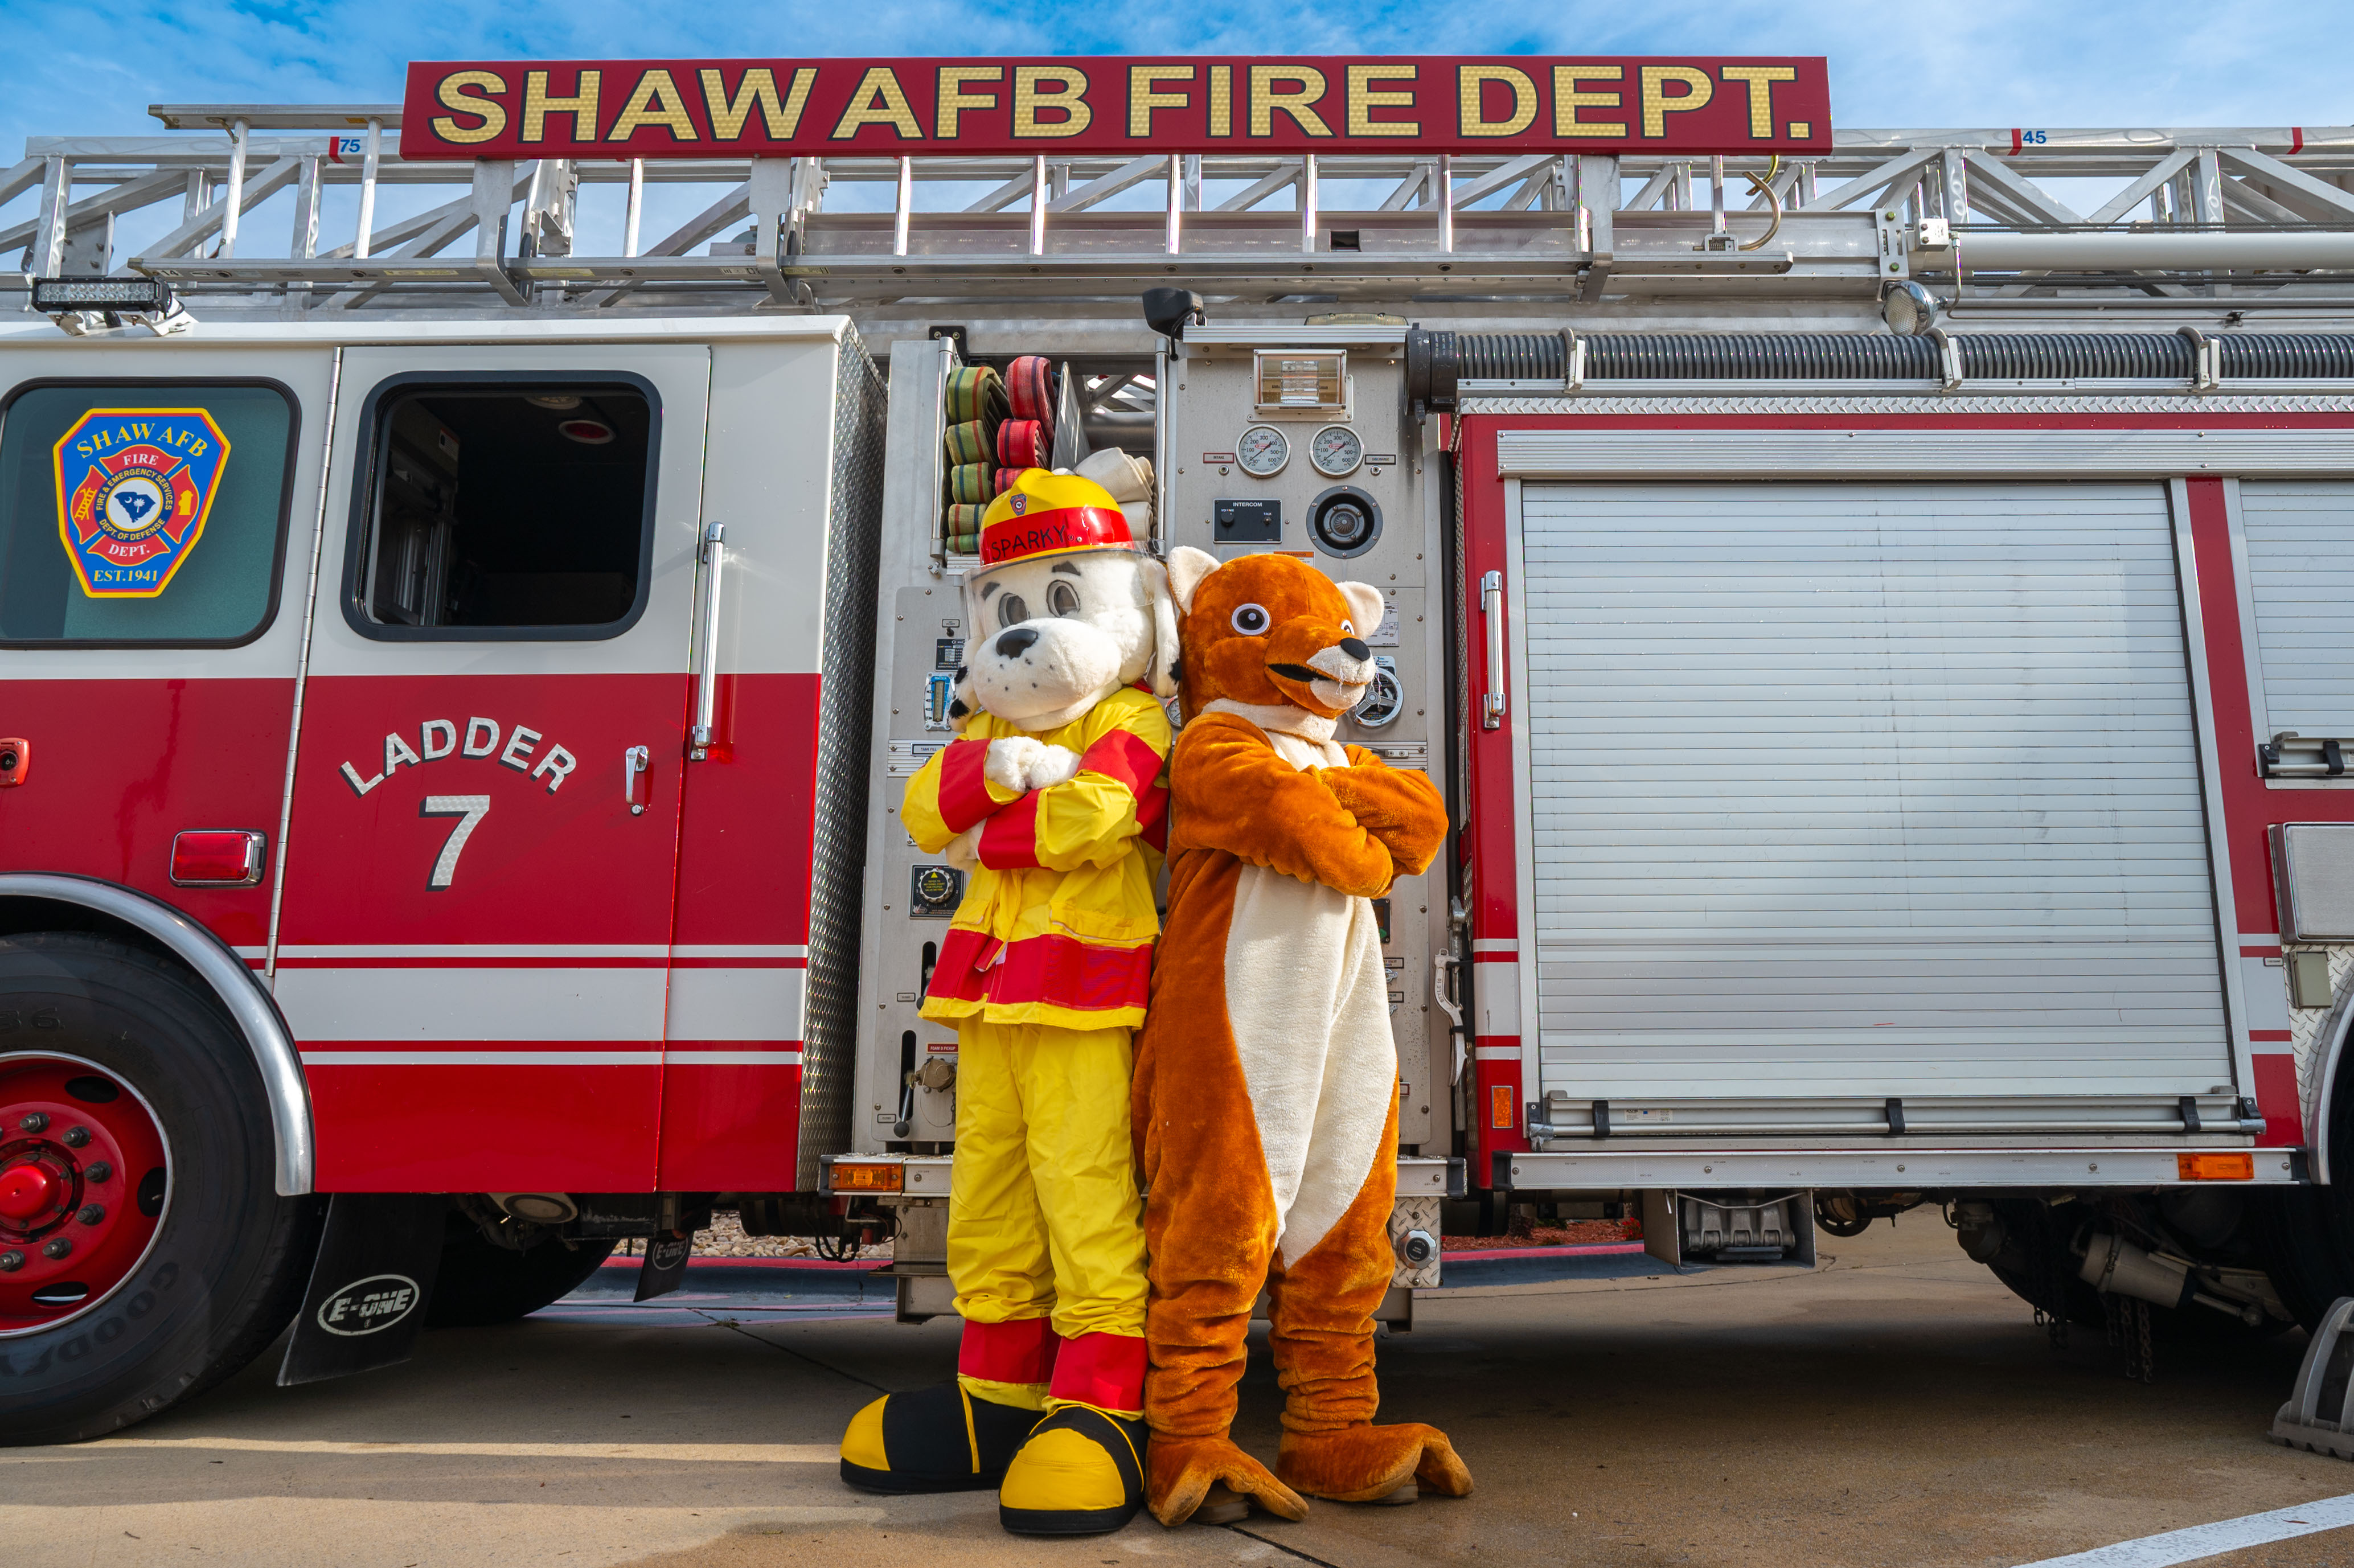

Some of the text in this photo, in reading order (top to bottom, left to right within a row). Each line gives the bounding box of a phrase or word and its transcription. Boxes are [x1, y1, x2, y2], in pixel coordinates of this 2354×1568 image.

[428, 64, 1813, 144] SHAW AFB FIRE DEPT.
[339, 139, 360, 153] 75
[2023, 130, 2047, 143] 45
[77, 423, 208, 458] SHAW AFB
[124, 454, 158, 466] FIRE
[96, 492, 106, 511] FIRE
[107, 468, 158, 487] EMERGENCY
[155, 475, 173, 510] SERVICES
[99, 519, 117, 537] DEPT.
[130, 518, 165, 540] DEFENSE
[991, 525, 1065, 561] SPARKY
[108, 544, 150, 557] DEPT.
[338, 716, 577, 798] LADDER
[419, 795, 490, 892] 7
[328, 1288, 412, 1322] E-ONE
